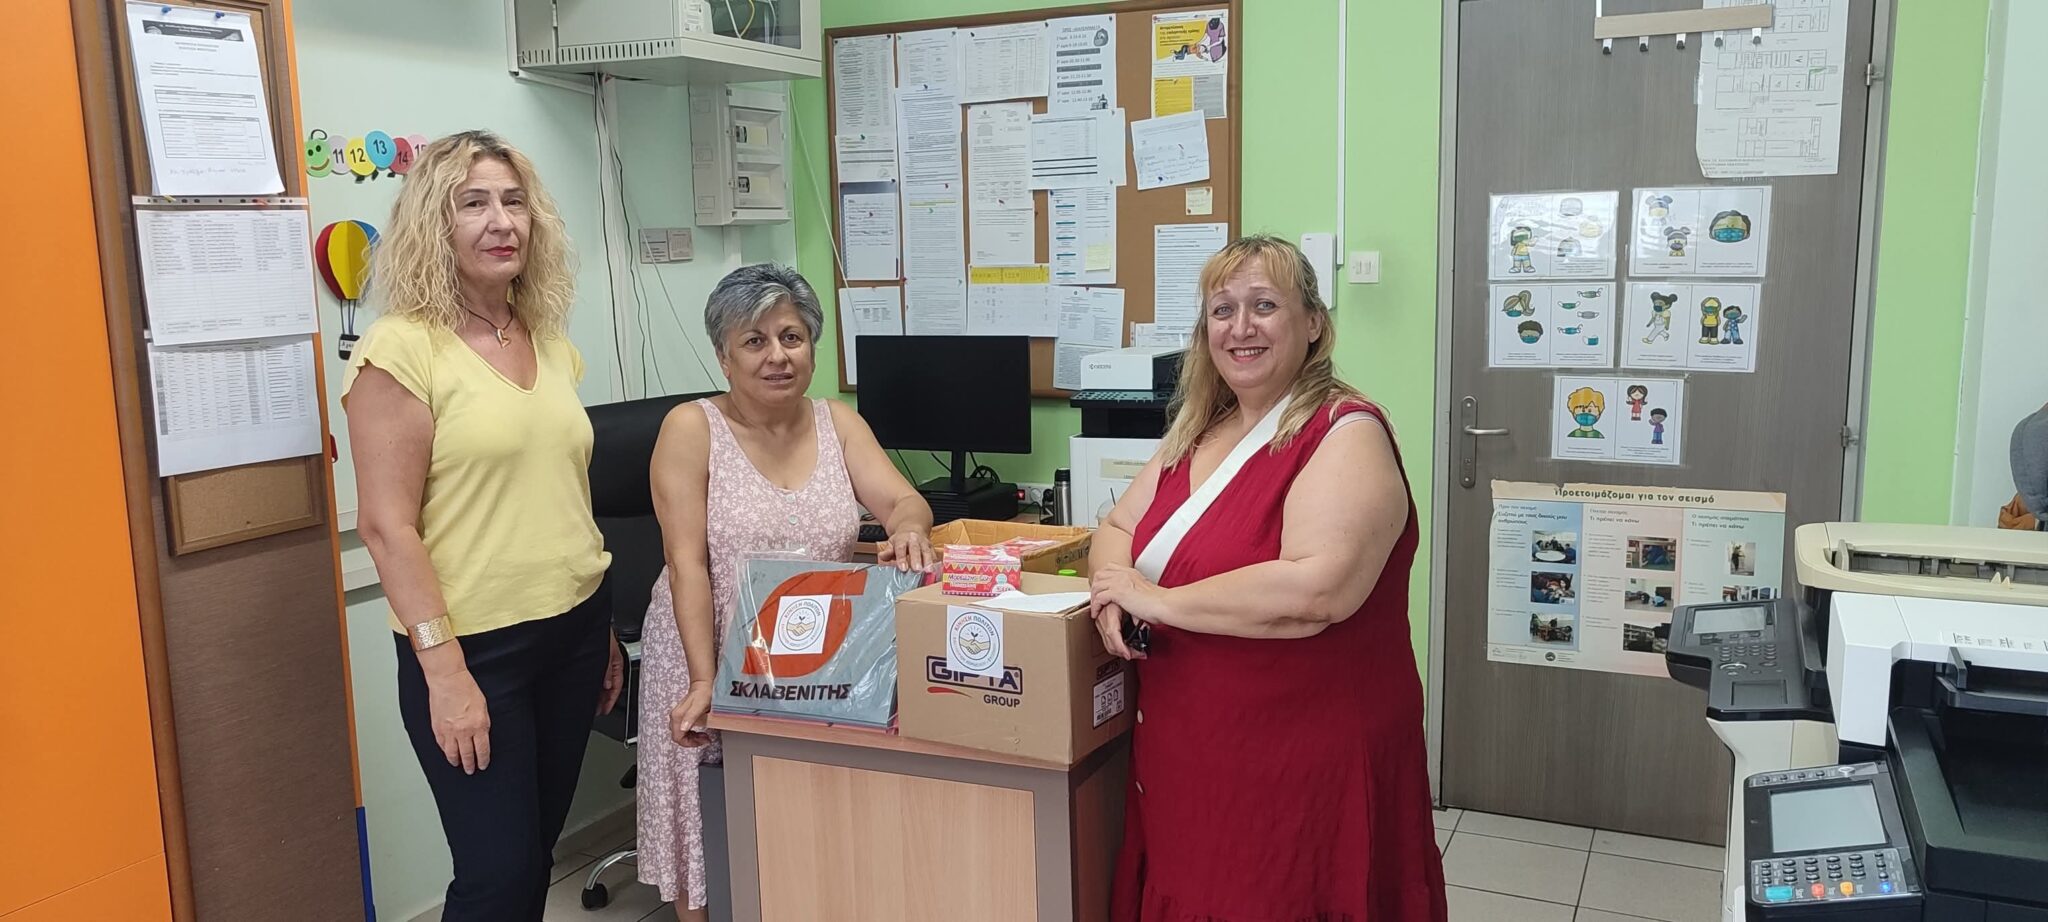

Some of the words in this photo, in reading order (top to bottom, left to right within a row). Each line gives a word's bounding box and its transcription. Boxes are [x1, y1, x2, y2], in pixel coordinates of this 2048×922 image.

[333, 149, 345, 164] 11
[350, 148, 366, 164] 12
[373, 139, 388, 155] 13
[398, 150, 409, 166] 14
[1553, 487, 1634, 500] Προετοιμάζομαι
[1638, 493, 1654, 502] για
[1657, 494, 1674, 502] τον
[1678, 494, 1715, 504] σεισμό
[954, 615, 973, 632] ΚΙΝΗΣΗ
[973, 615, 995, 636] ΠΟΛΙΤΩΝ
[729, 680, 852, 701] ΣΚΛΑΒΕΝΙΤΗΣ
[983, 694, 1021, 708] GROUP
